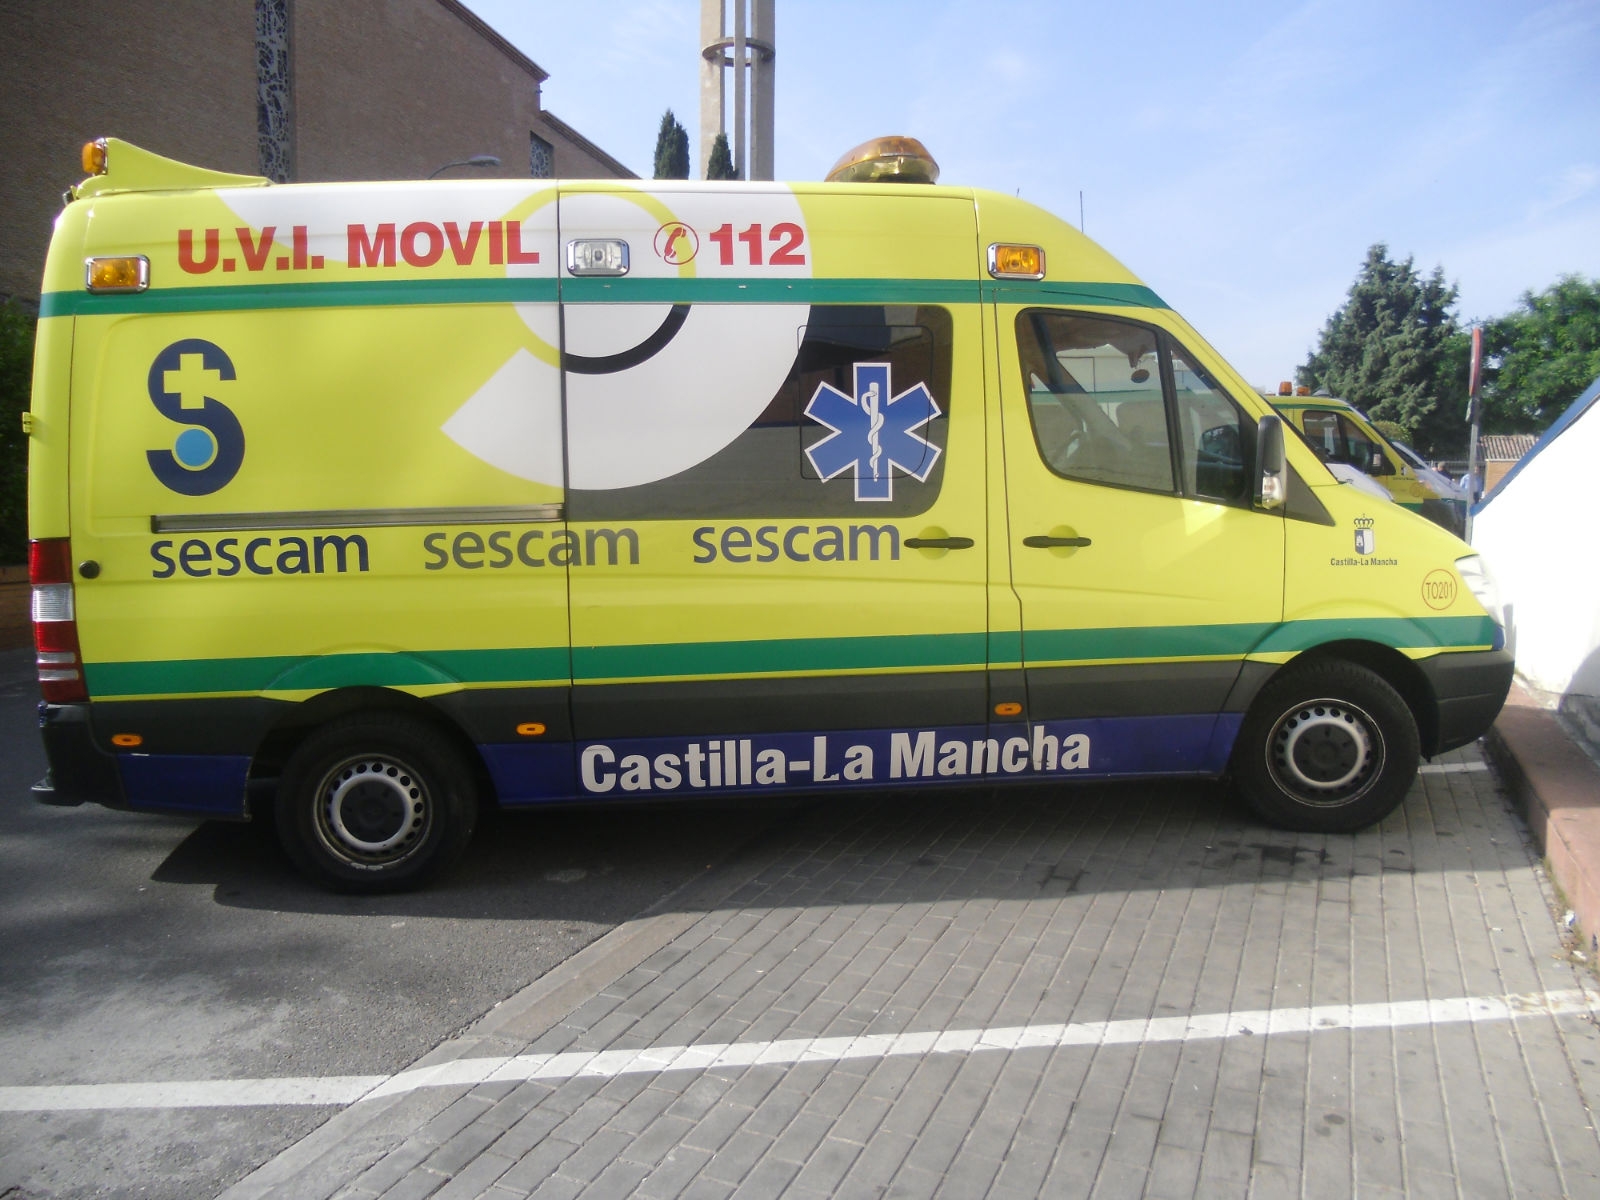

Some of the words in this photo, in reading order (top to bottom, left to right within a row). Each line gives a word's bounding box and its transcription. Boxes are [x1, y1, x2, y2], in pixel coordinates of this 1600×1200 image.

[178, 225, 325, 275] U.V.I.
[347, 220, 540, 268] MOVIL
[709, 222, 806, 266] 112
[150, 533, 370, 579] sescam
[423, 528, 640, 571] sescam
[692, 523, 901, 564] sescam
[1330, 558, 1369, 566] Castilla-La
[1370, 558, 1398, 566] Mancha
[1426, 582, 1453, 599] TO201
[580, 735, 874, 793] Castilla-La
[889, 725, 1091, 779] Mancha
